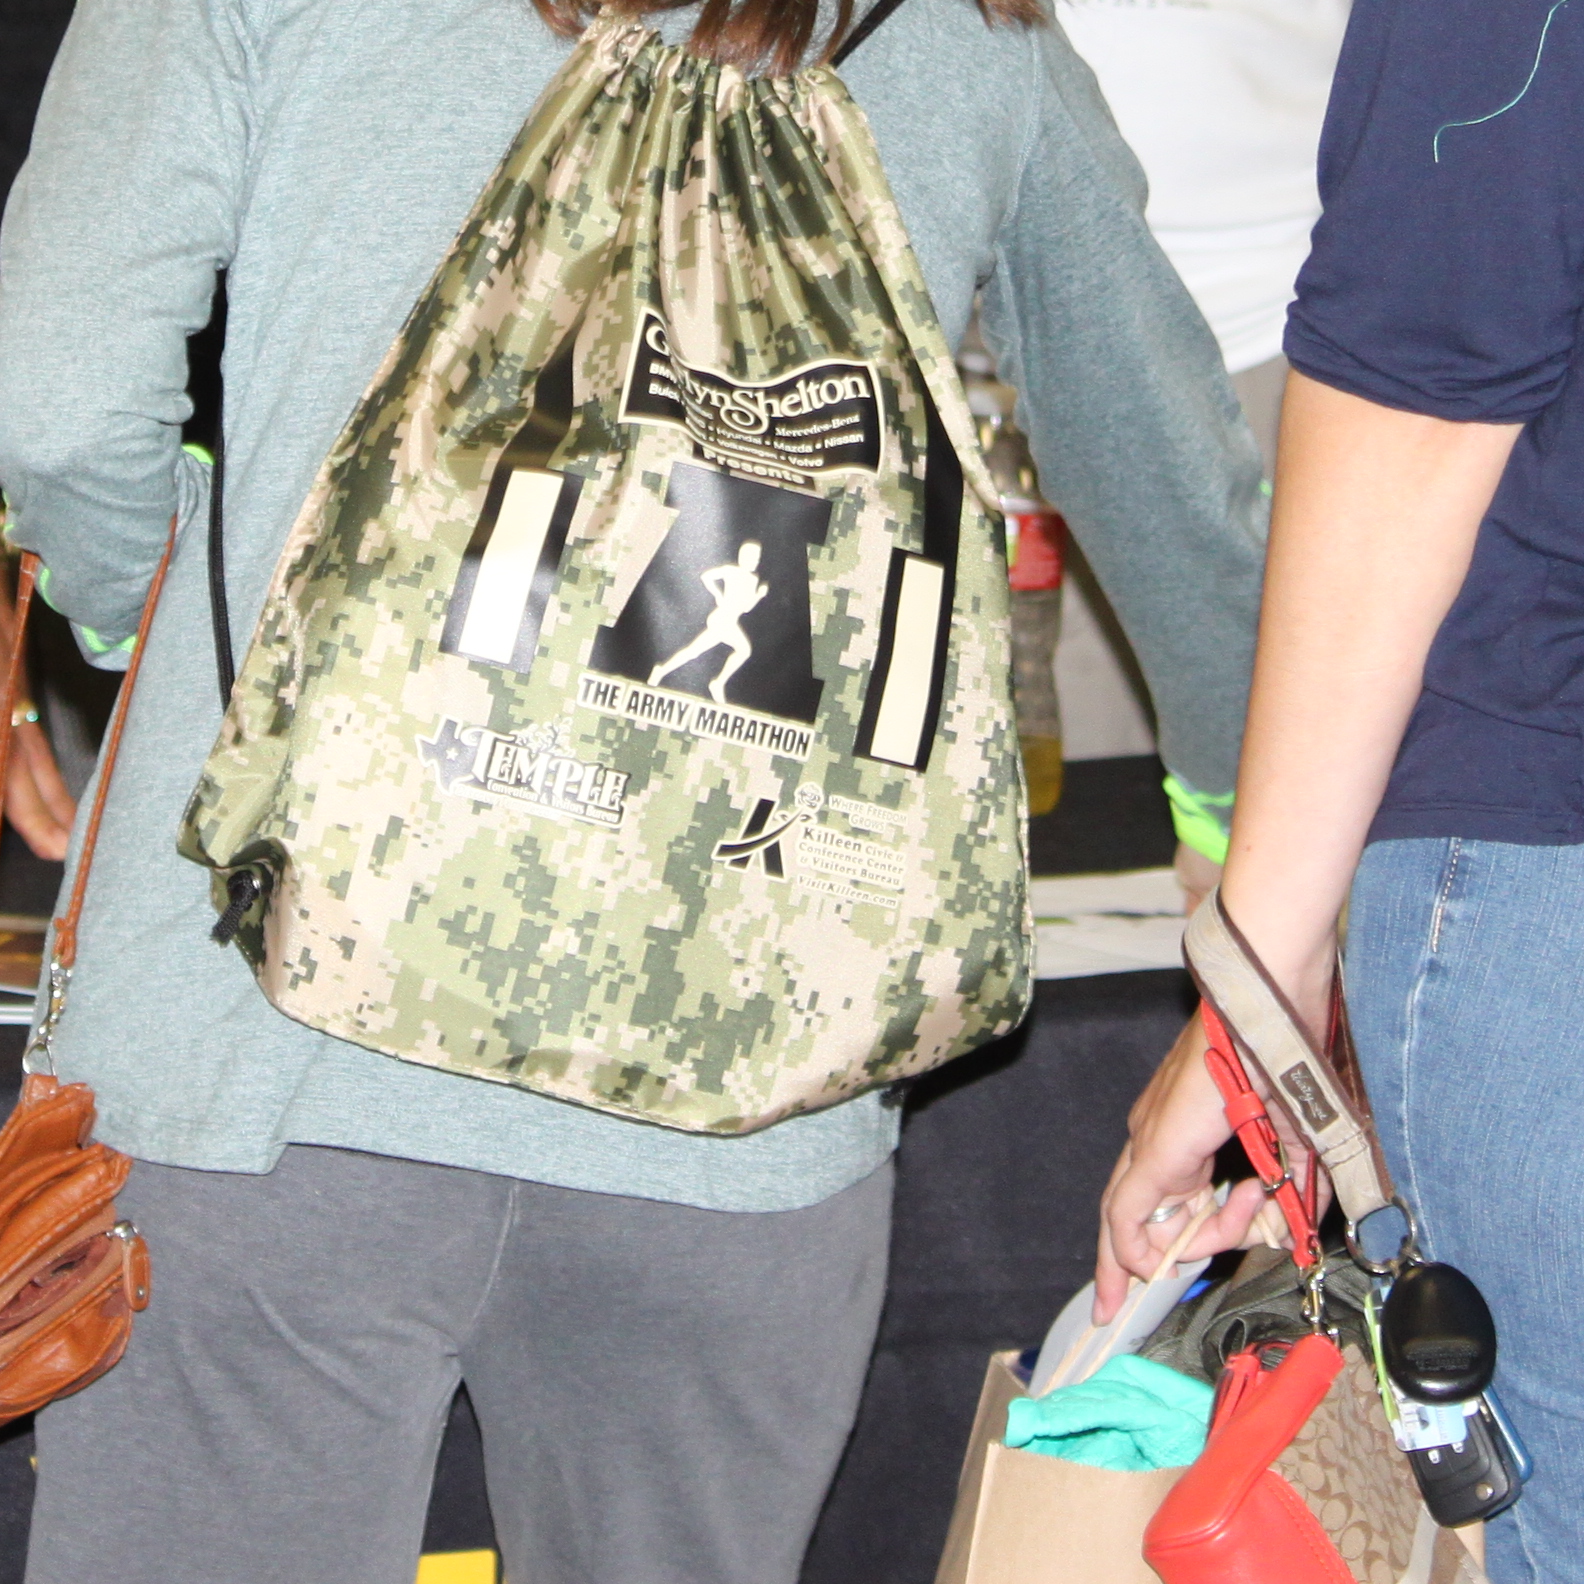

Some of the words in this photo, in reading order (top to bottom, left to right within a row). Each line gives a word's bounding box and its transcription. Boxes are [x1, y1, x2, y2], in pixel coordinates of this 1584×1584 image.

[773, 441, 813, 453] Mazda
[824, 433, 865, 449] Nissan
[702, 447, 805, 485] Presents
[788, 455, 824, 467] Volvo
[582, 678, 622, 709] THE
[625, 690, 690, 726] ARMY
[694, 707, 811, 757] MARATHON
[460, 725, 630, 812] TEMPLE
[830, 796, 864, 812] WHERE
[867, 807, 907, 823] FREEDOM
[850, 814, 885, 830] GROWS
[799, 842, 863, 865] Conference
[867, 858, 904, 874] Center
[803, 827, 862, 852] Killeen
[866, 843, 893, 860] Civic
[813, 858, 858, 875] Visitors
[861, 868, 901, 886] Bureau
[799, 876, 897, 907] VisitKilleen.com
